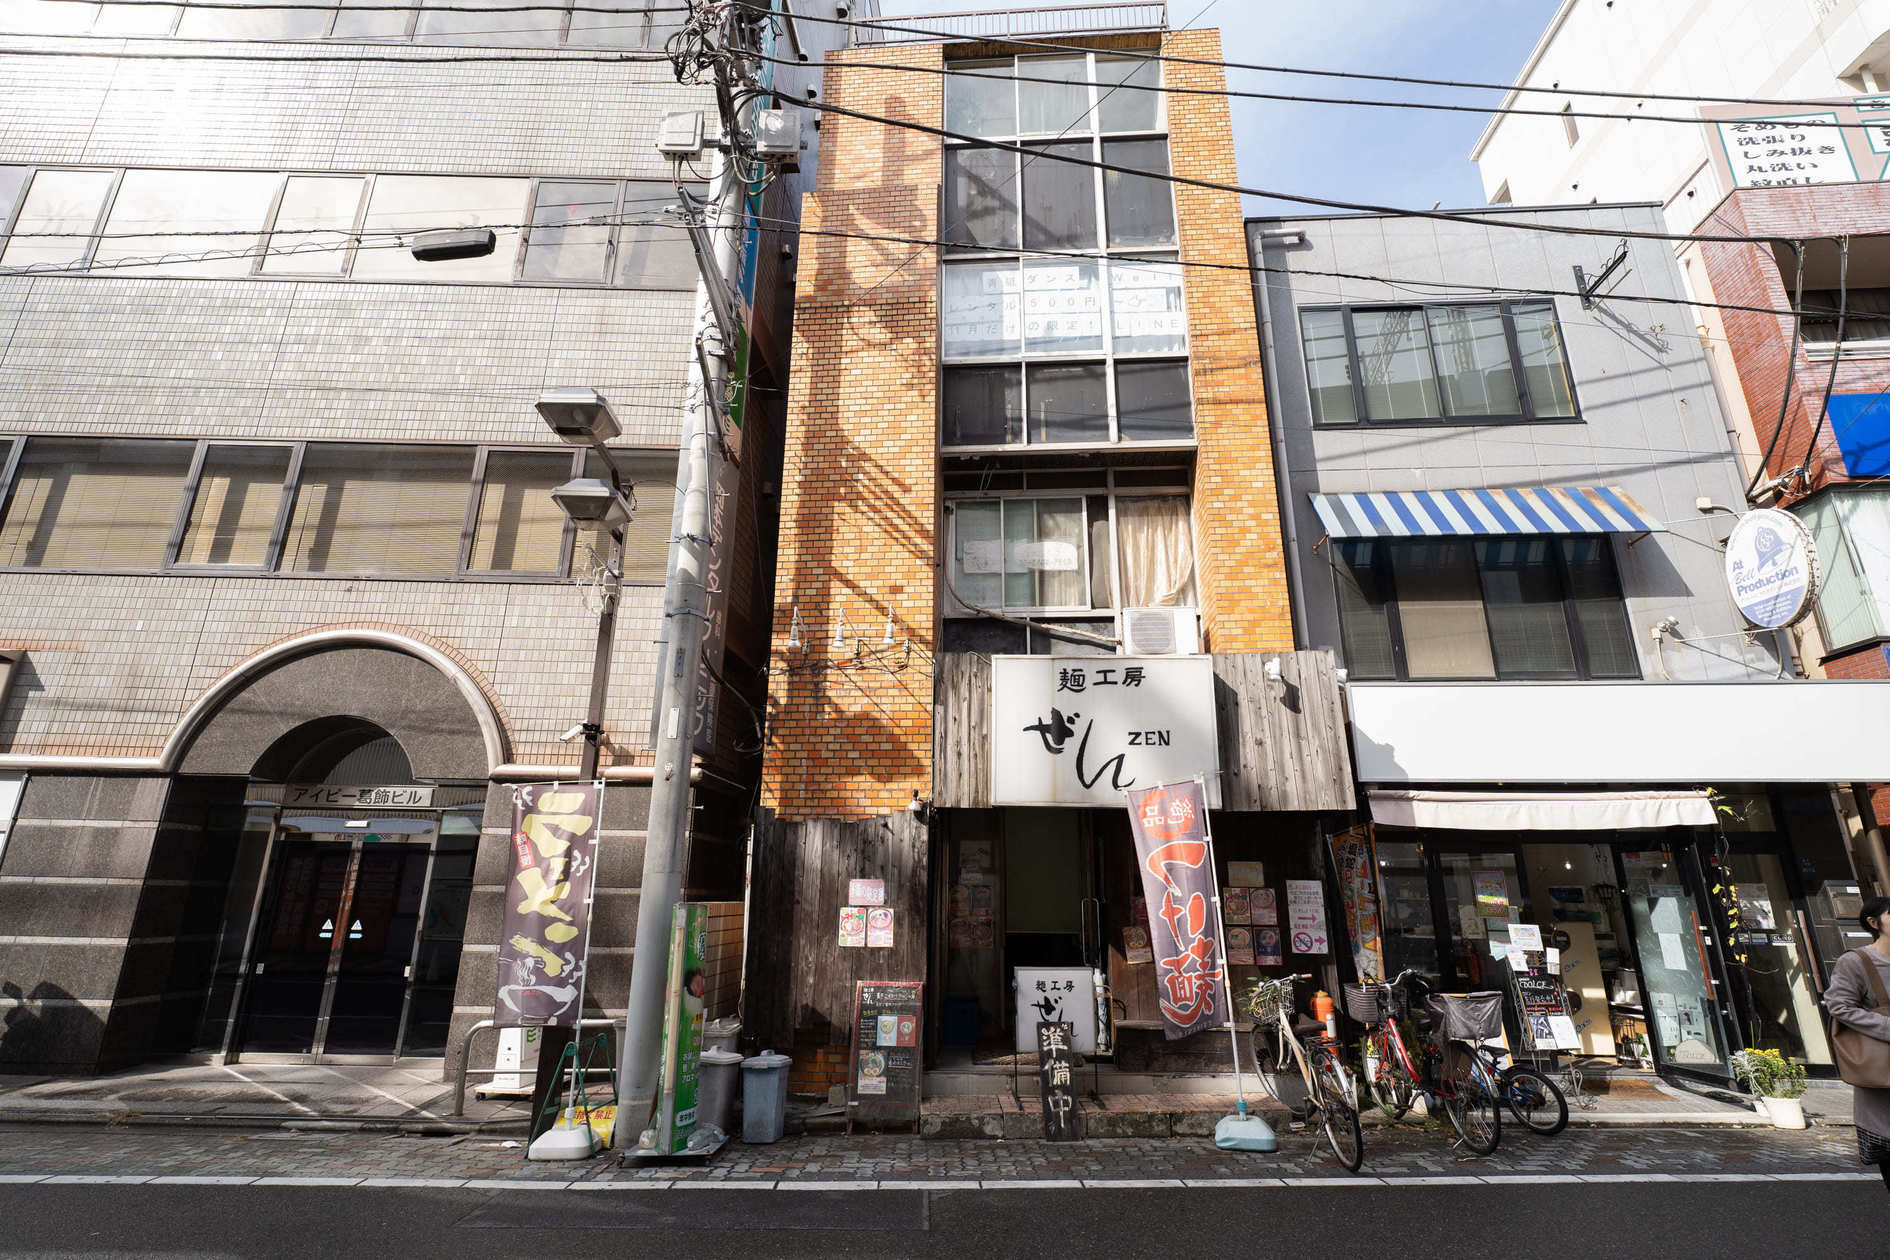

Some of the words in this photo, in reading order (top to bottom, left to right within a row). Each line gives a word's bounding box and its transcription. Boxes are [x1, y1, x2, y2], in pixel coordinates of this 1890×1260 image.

[1743, 145, 1836, 159] しみ抜き
[1747, 162, 1819, 174] 丸洗い
[1737, 566, 1799, 597] Production
[1057, 667, 1146, 693] 麺工房
[1128, 730, 1171, 746] ZEN
[1022, 707, 1136, 791] ぜん
[1036, 980, 1075, 993] 麺工房
[1041, 1027, 1073, 1129] 準備中
